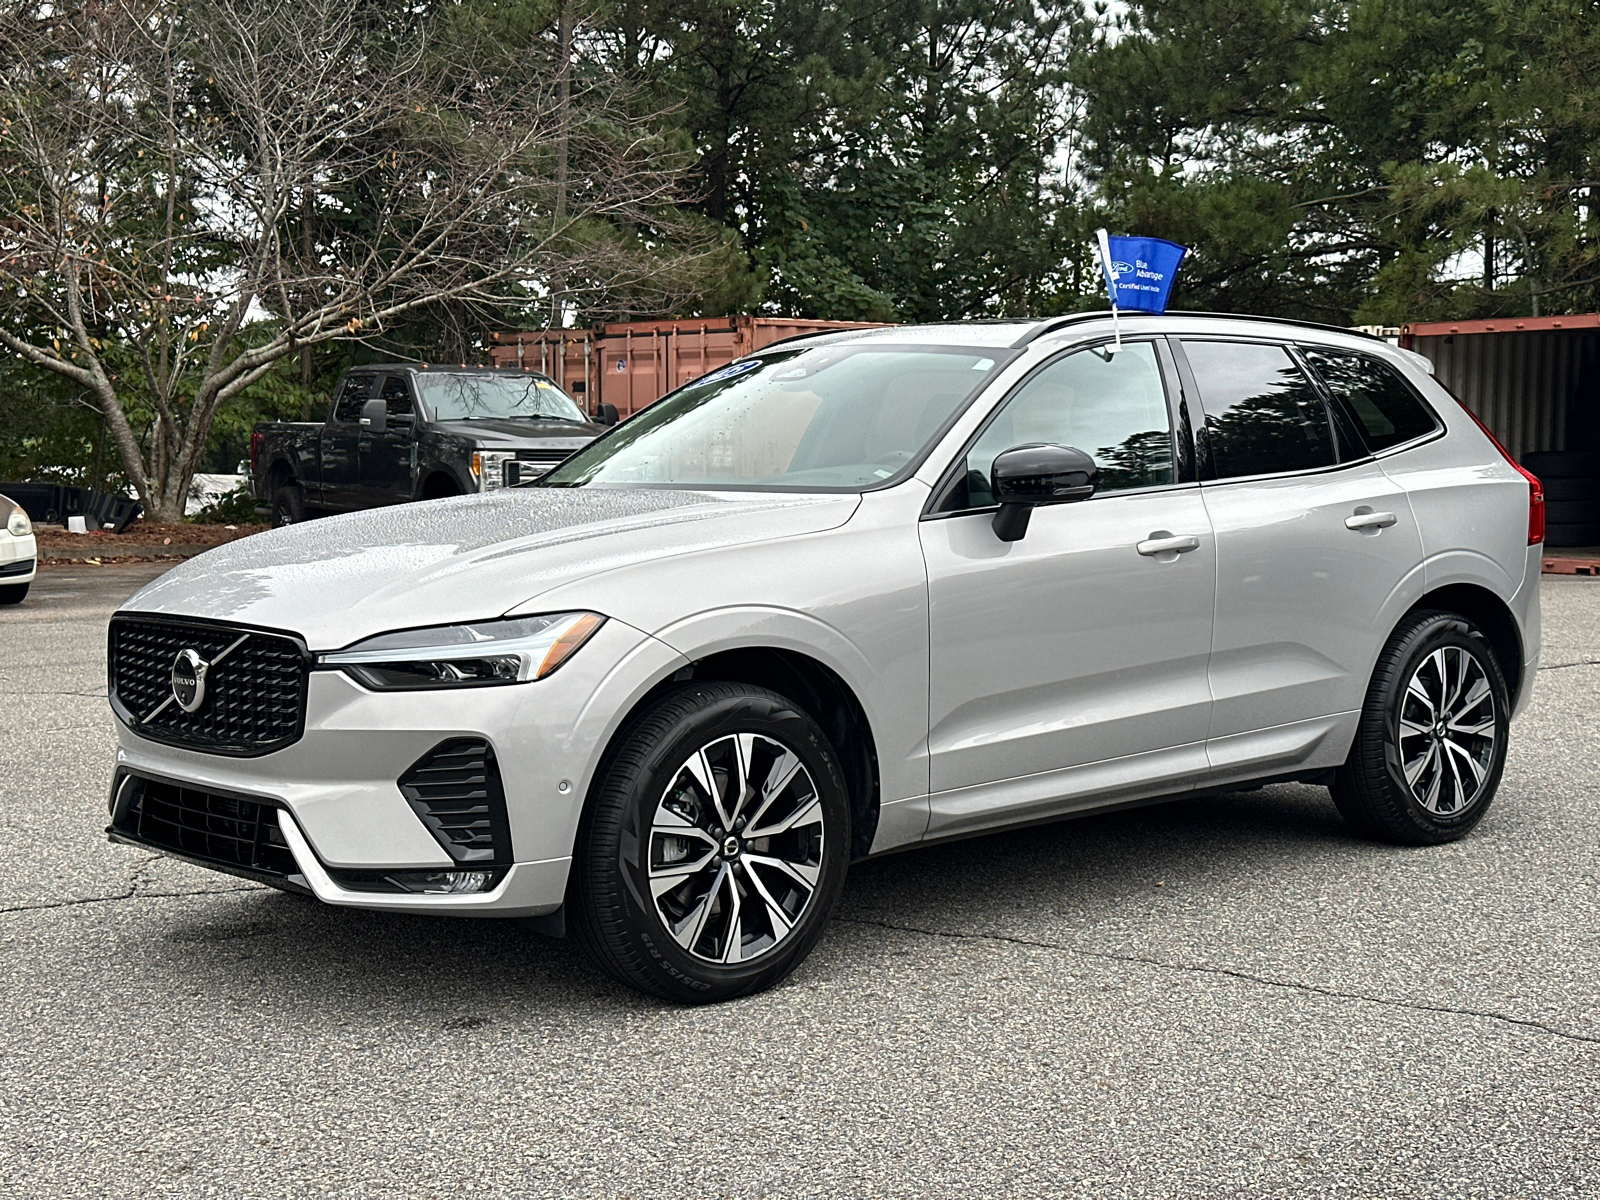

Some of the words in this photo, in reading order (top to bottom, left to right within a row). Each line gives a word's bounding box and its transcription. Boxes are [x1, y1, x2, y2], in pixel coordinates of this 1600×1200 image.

[1111, 262, 1129, 272] Ford
[1136, 260, 1148, 269] Blue
[174, 676, 195, 686] VOLVO
[641, 932, 662, 959] R19
[660, 960, 712, 991] 235/55
